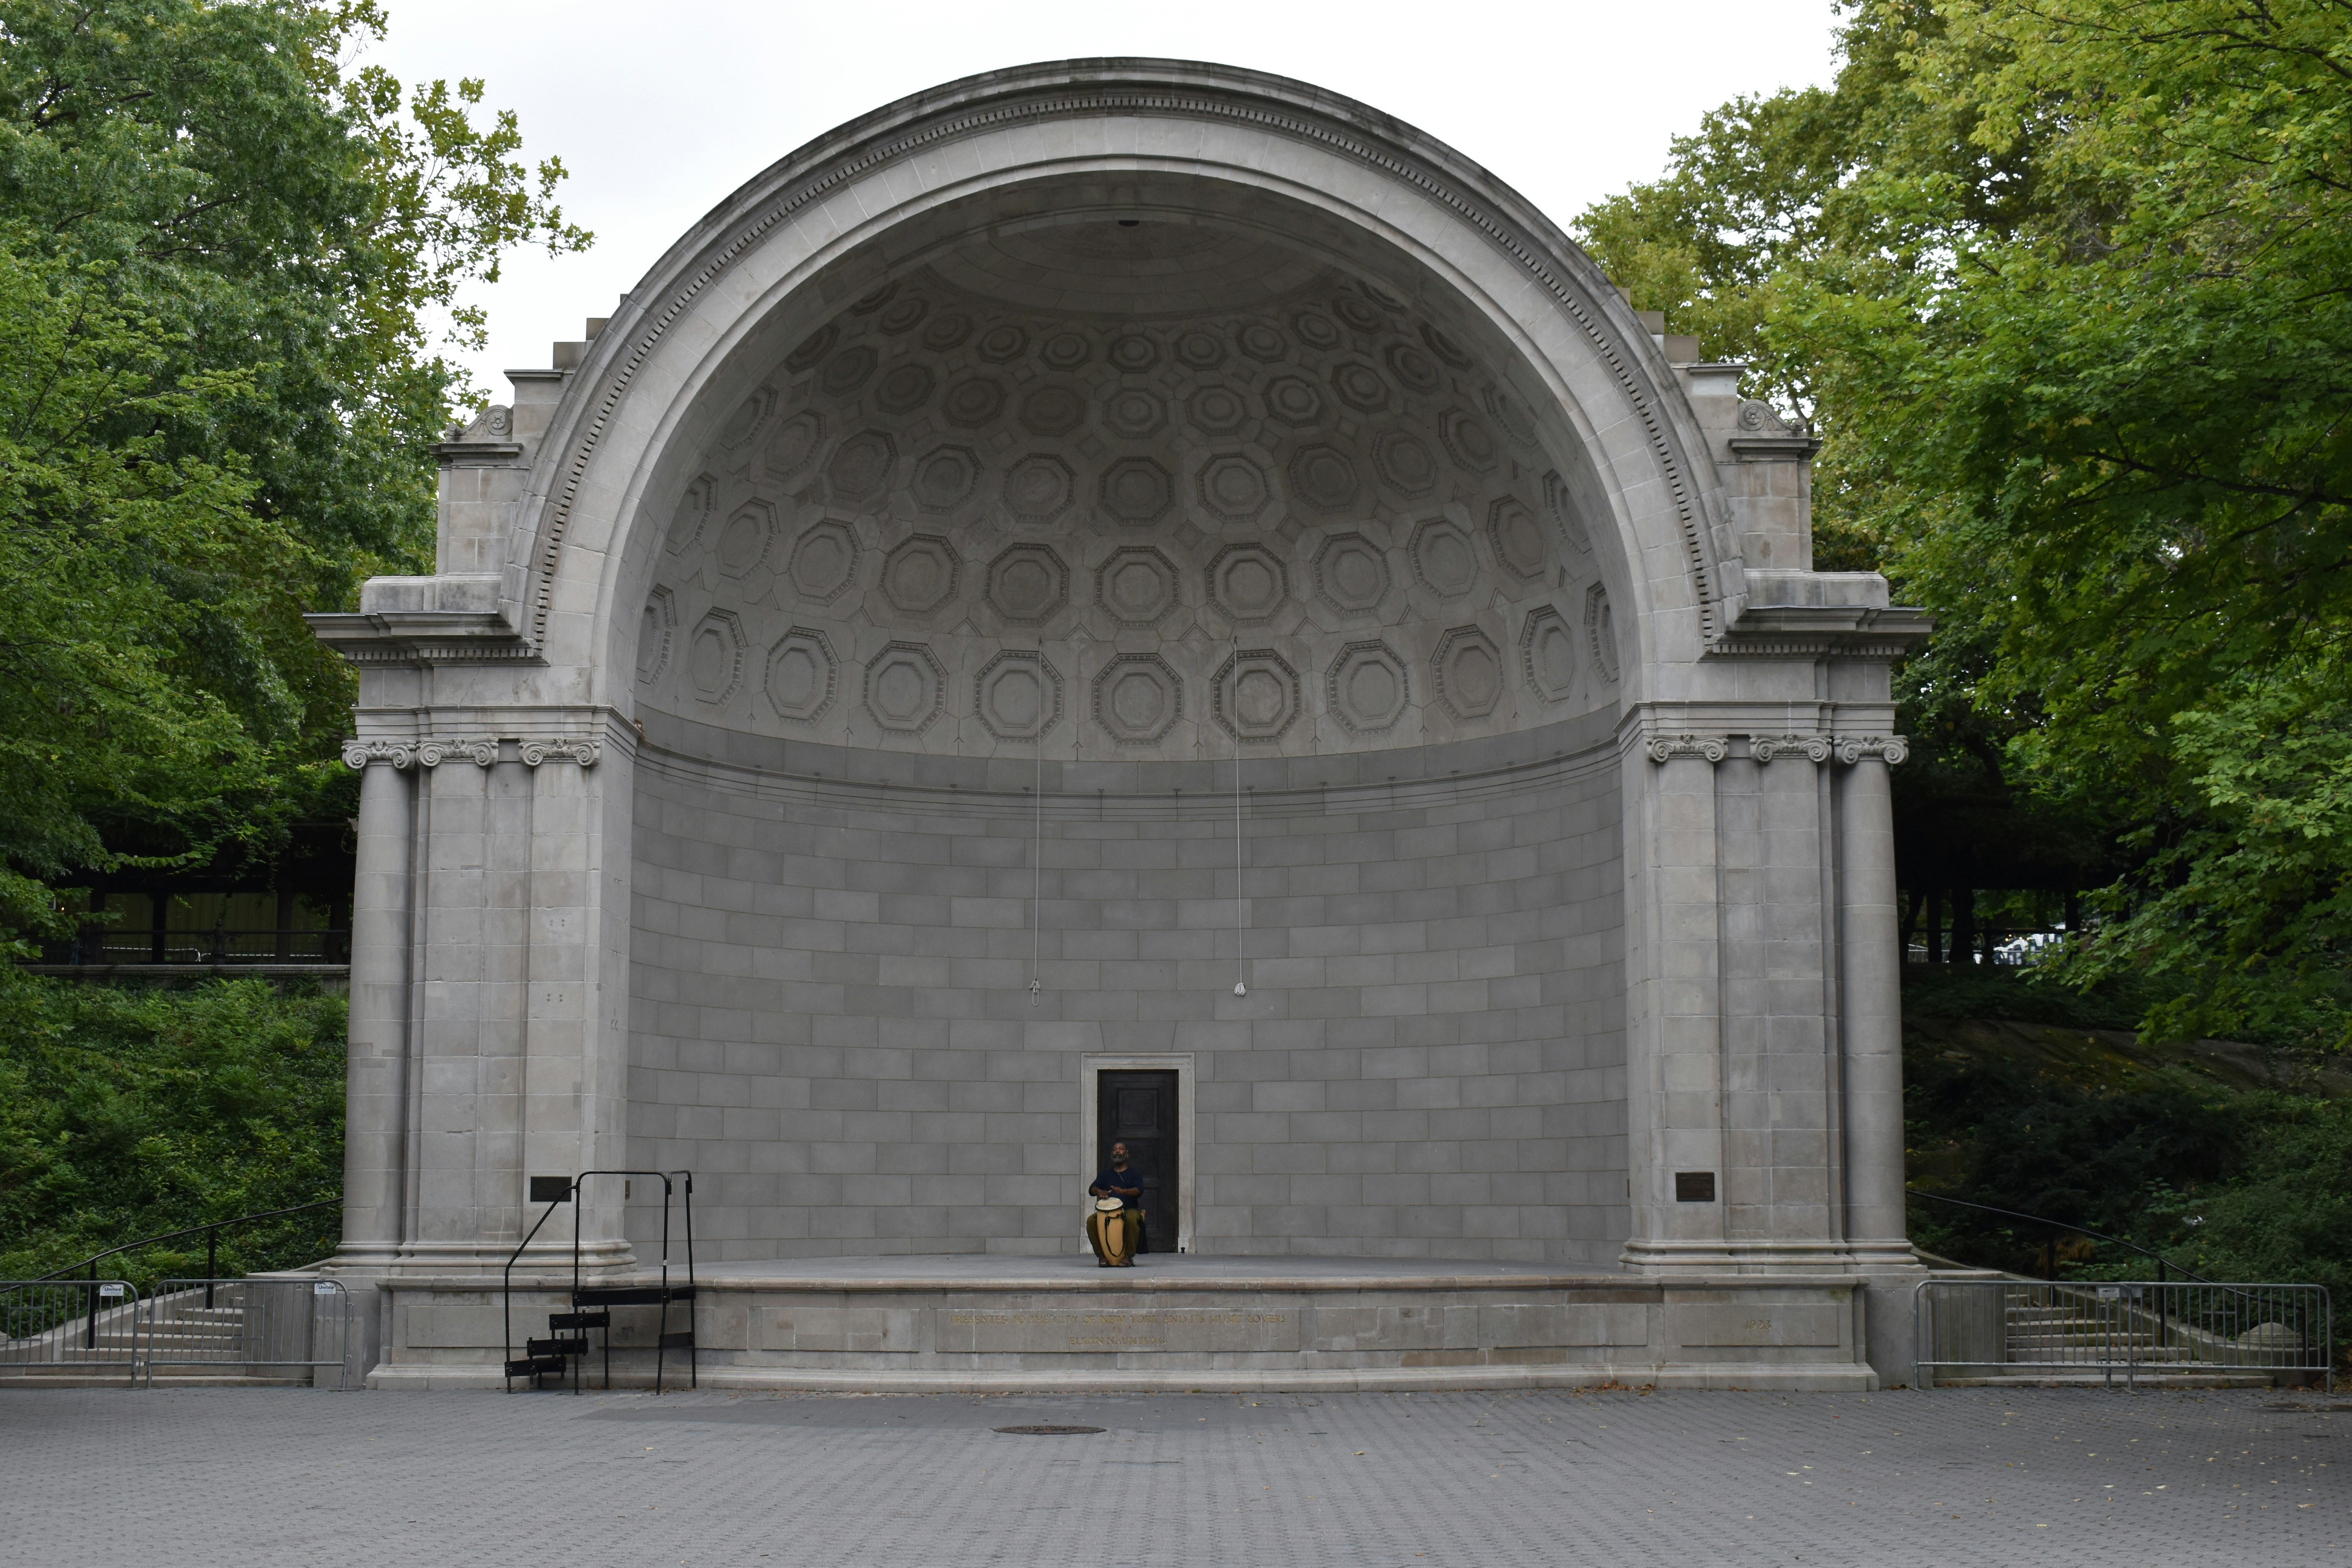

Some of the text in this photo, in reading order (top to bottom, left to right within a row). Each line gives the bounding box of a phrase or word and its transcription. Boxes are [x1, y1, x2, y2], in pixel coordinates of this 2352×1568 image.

[950, 1314, 1287, 1324] PRESENTED TO THE CITY OF NEW YORK AND ITS MUSIC LOVERS
[1745, 1320, 1772, 1330] 1923
[1070, 1336, 1166, 1345] ELKAN NAUMBURG
